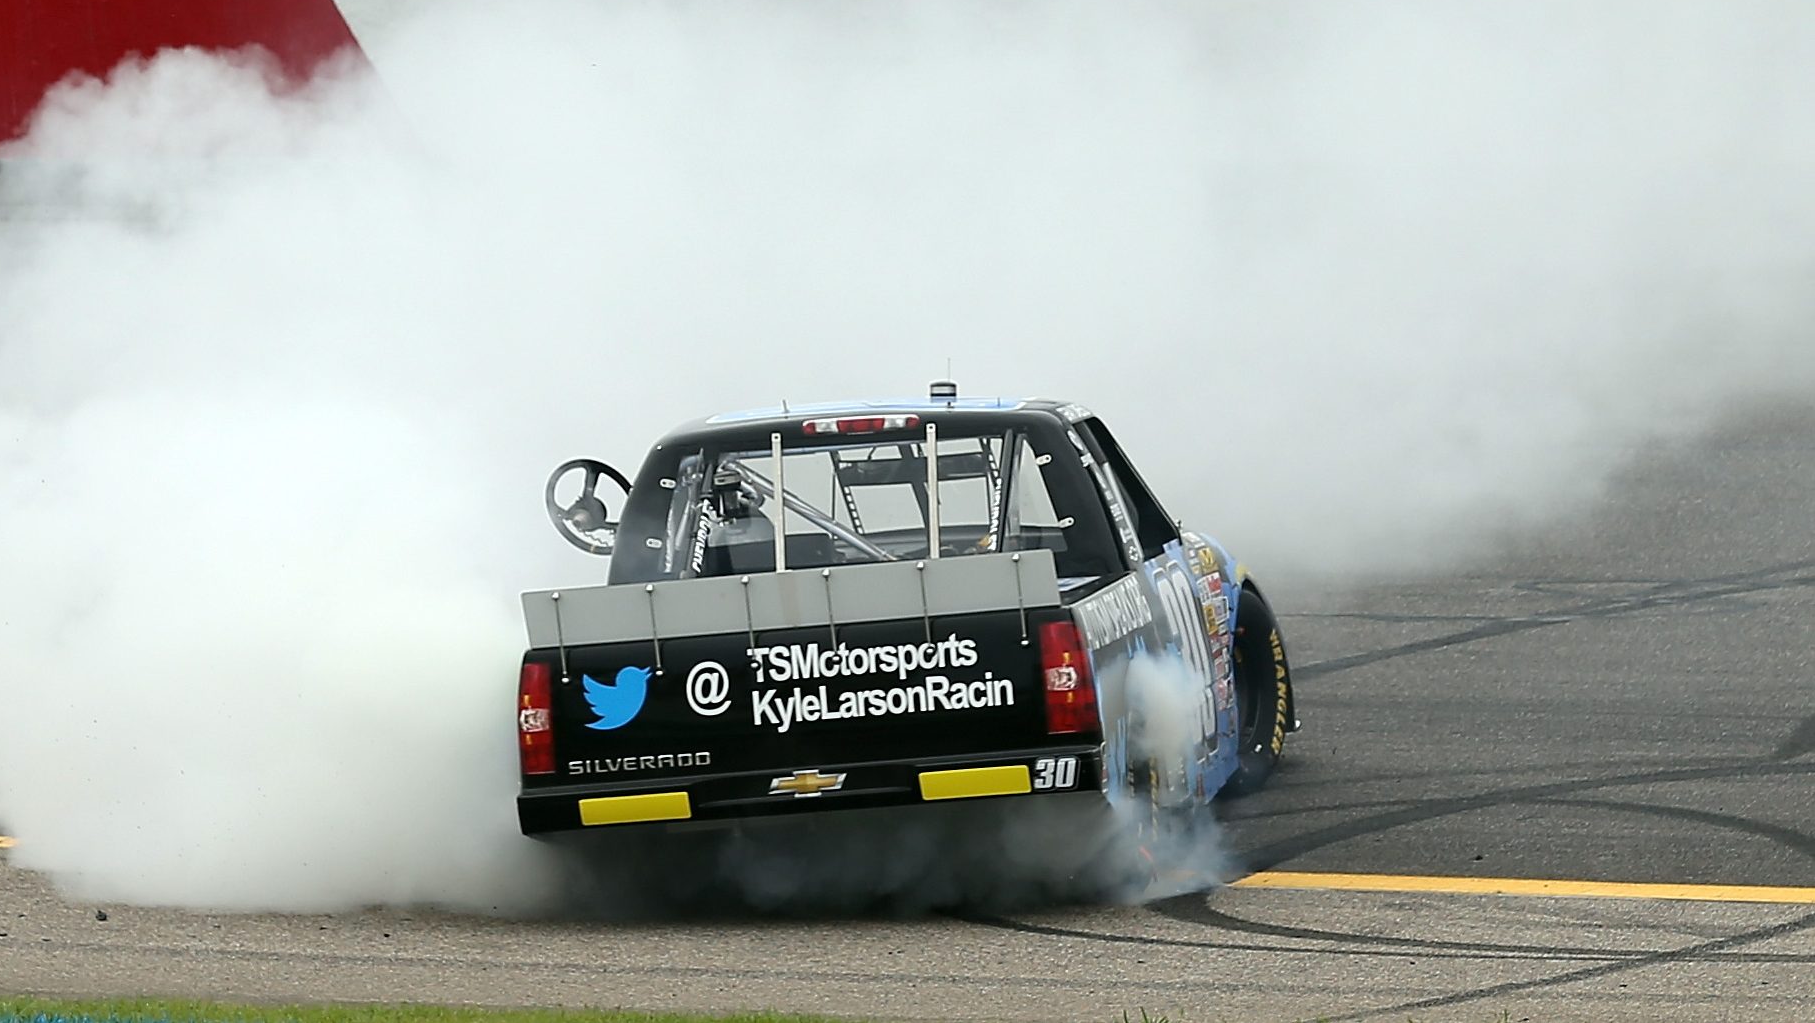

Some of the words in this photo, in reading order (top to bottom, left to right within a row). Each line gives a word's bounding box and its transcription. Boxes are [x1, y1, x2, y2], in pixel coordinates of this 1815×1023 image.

[747, 633, 979, 682] TSMotorsports
[686, 661, 732, 716] @
[751, 672, 1015, 733] KyleLarsonRacin
[568, 751, 711, 775] SILVERADO
[1033, 757, 1077, 789] 30
